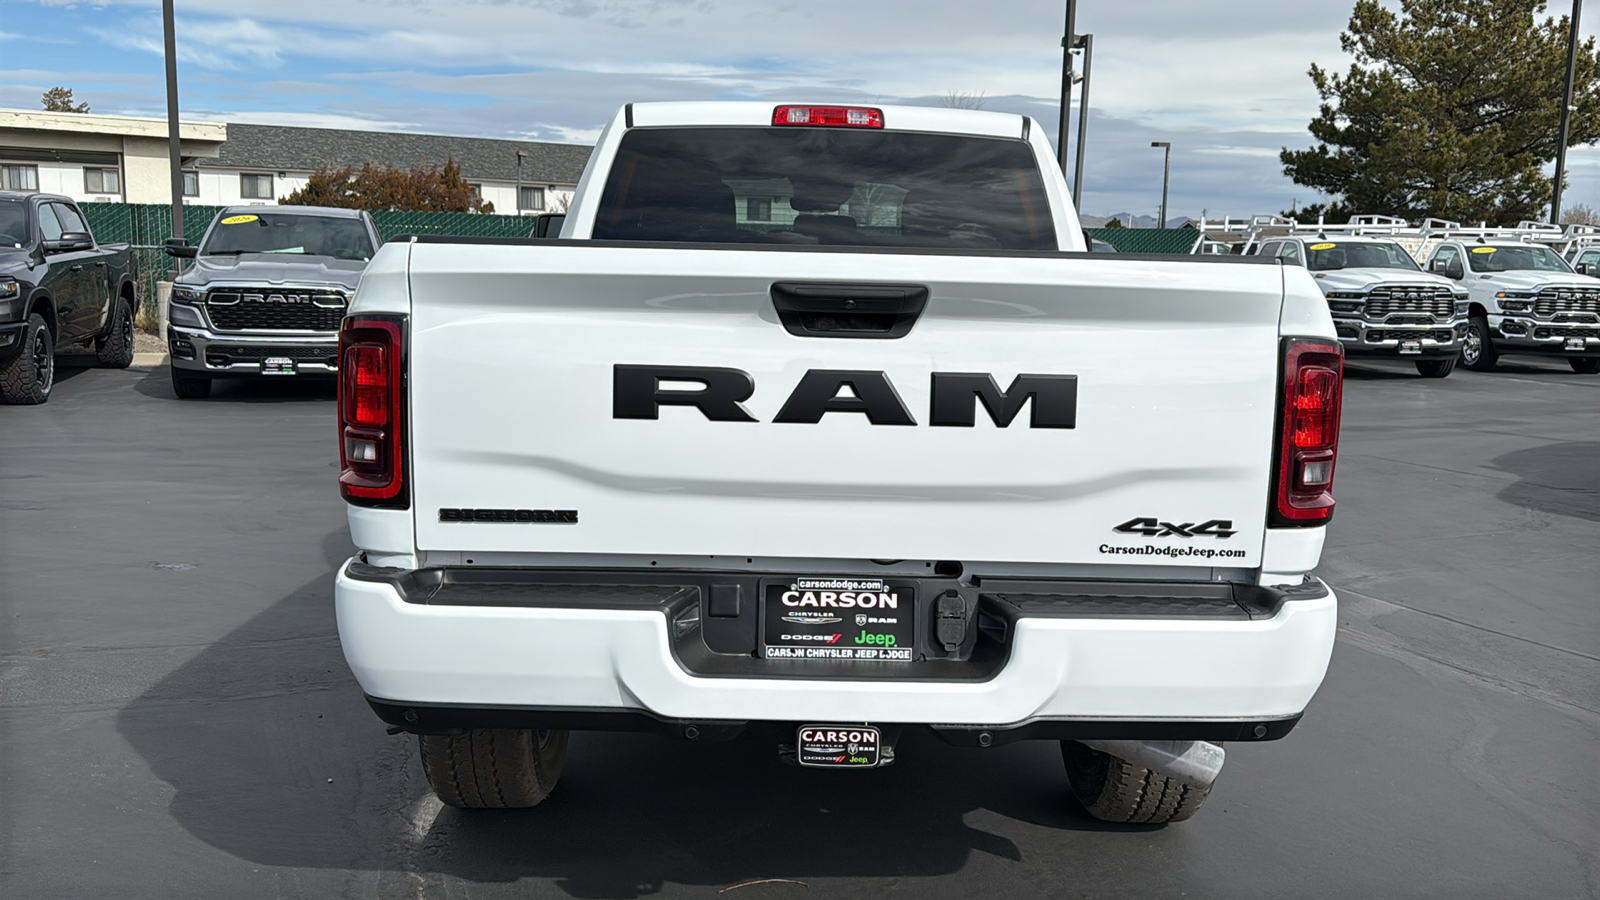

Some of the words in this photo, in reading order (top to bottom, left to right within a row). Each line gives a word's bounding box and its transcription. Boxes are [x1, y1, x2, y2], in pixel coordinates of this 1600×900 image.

[243, 293, 309, 303] RAM
[613, 364, 1078, 429] RAM
[1112, 517, 1239, 539] 4x4
[1098, 544, 1246, 558] CarsonDodgeJeep.com
[799, 579, 881, 590] carsondodge.com
[781, 591, 898, 608] CARSON
[854, 630, 896, 647] Jeep
[806, 649, 853, 658] CHRYSLER
[855, 649, 878, 658] JEEP
[802, 731, 875, 742] CARSON
[849, 756, 868, 764] Jeep
